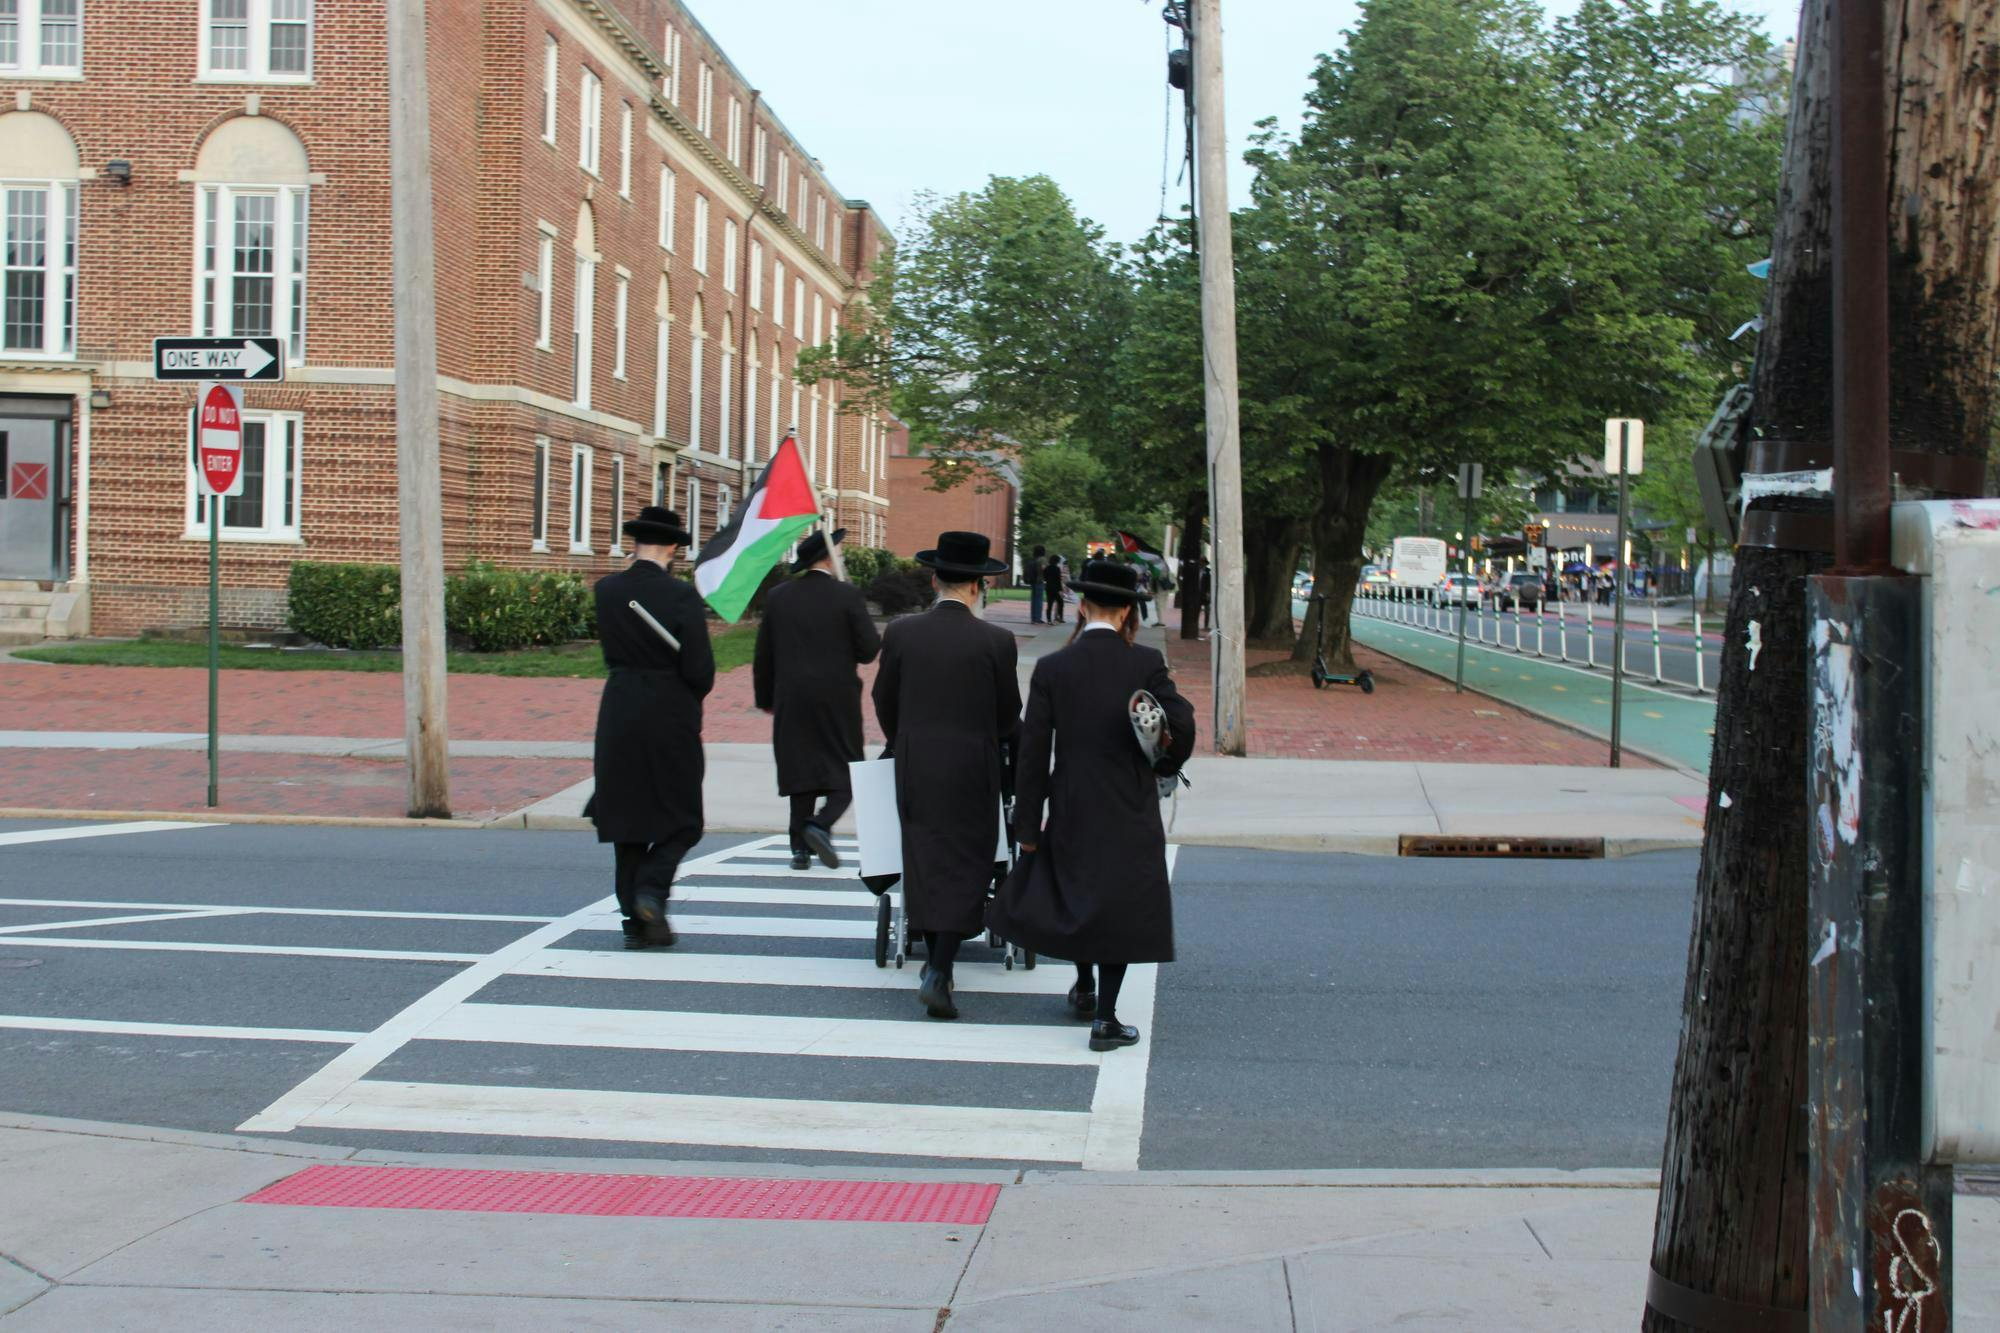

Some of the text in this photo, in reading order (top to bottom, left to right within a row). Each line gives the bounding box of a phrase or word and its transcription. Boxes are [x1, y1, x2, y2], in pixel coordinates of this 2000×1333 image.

[167, 351, 241, 367] ONE WAY
[204, 406, 236, 424] DO NOT
[207, 455, 232, 471] ENTER
